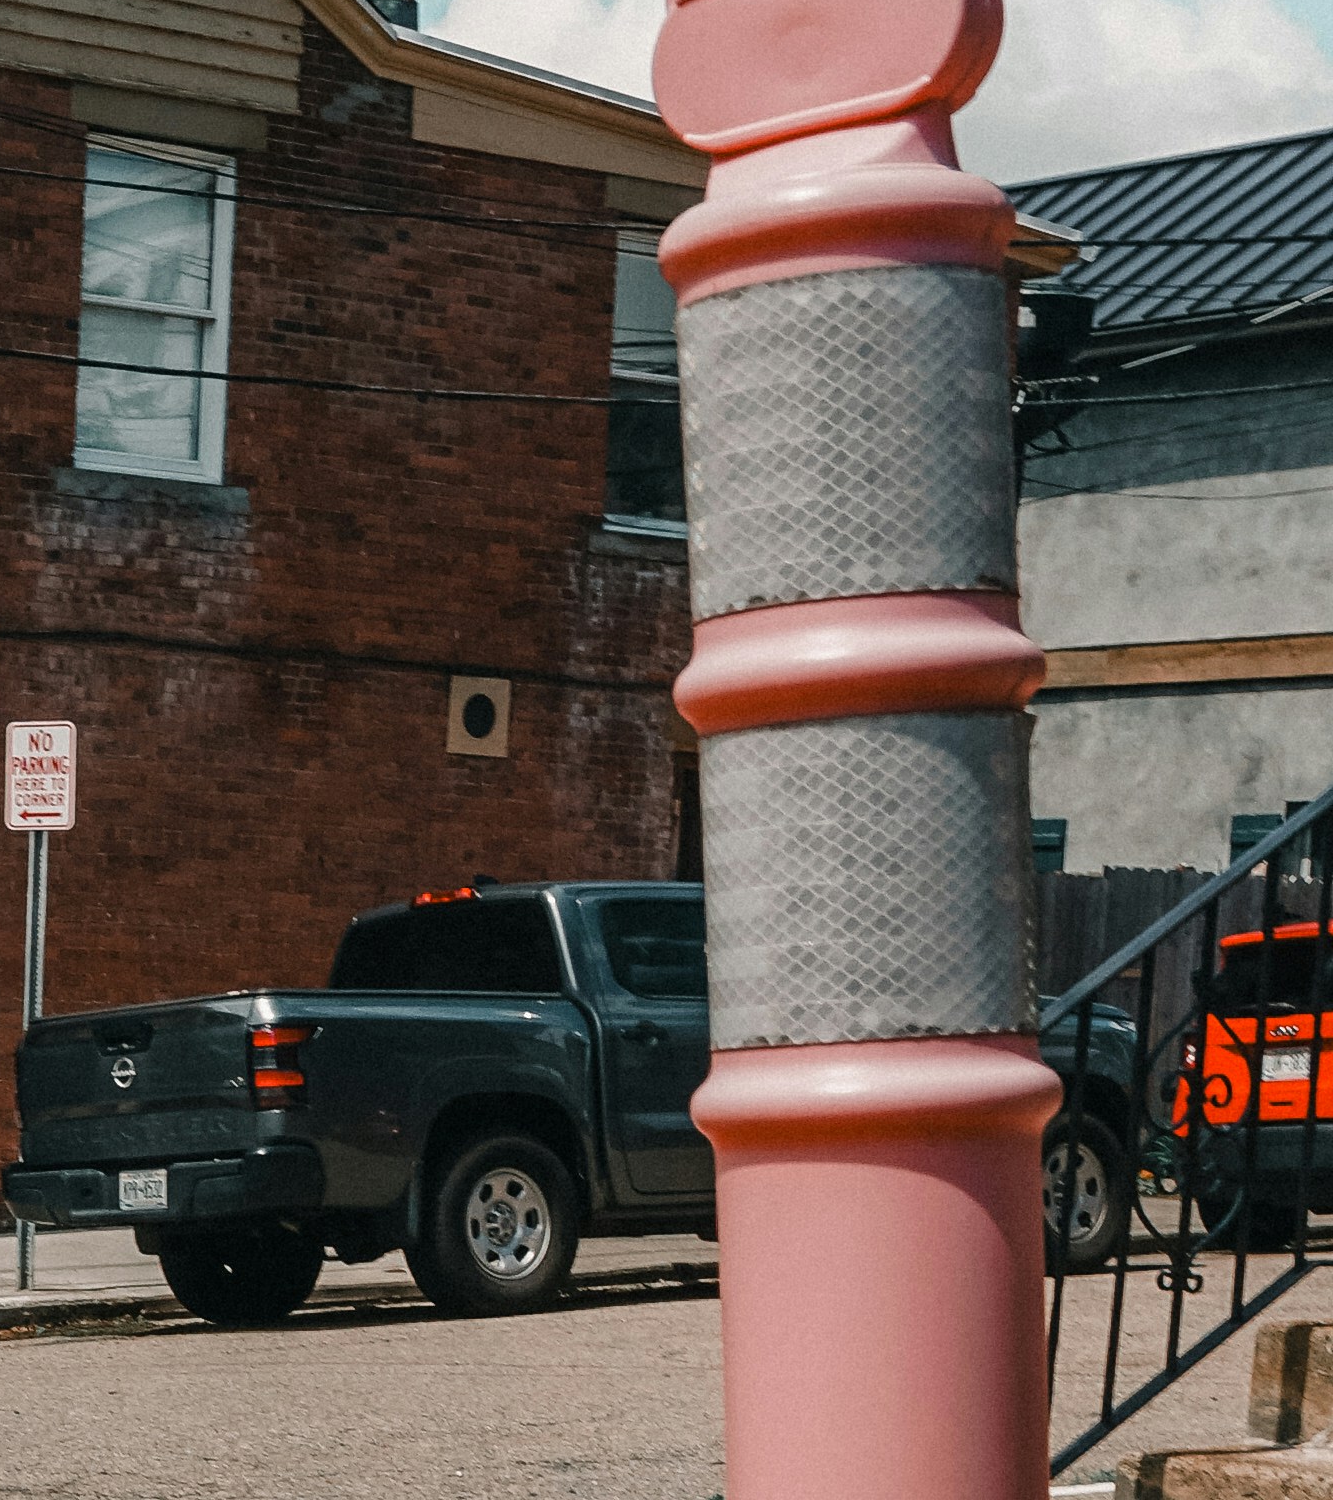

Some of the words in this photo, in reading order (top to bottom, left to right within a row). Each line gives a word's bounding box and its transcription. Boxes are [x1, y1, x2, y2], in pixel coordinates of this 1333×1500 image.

[28, 732, 53, 753] NO
[12, 756, 70, 775] PARKING
[14, 778, 47, 792] HERE
[51, 777, 67, 791] TO
[14, 793, 66, 807] CORNER
